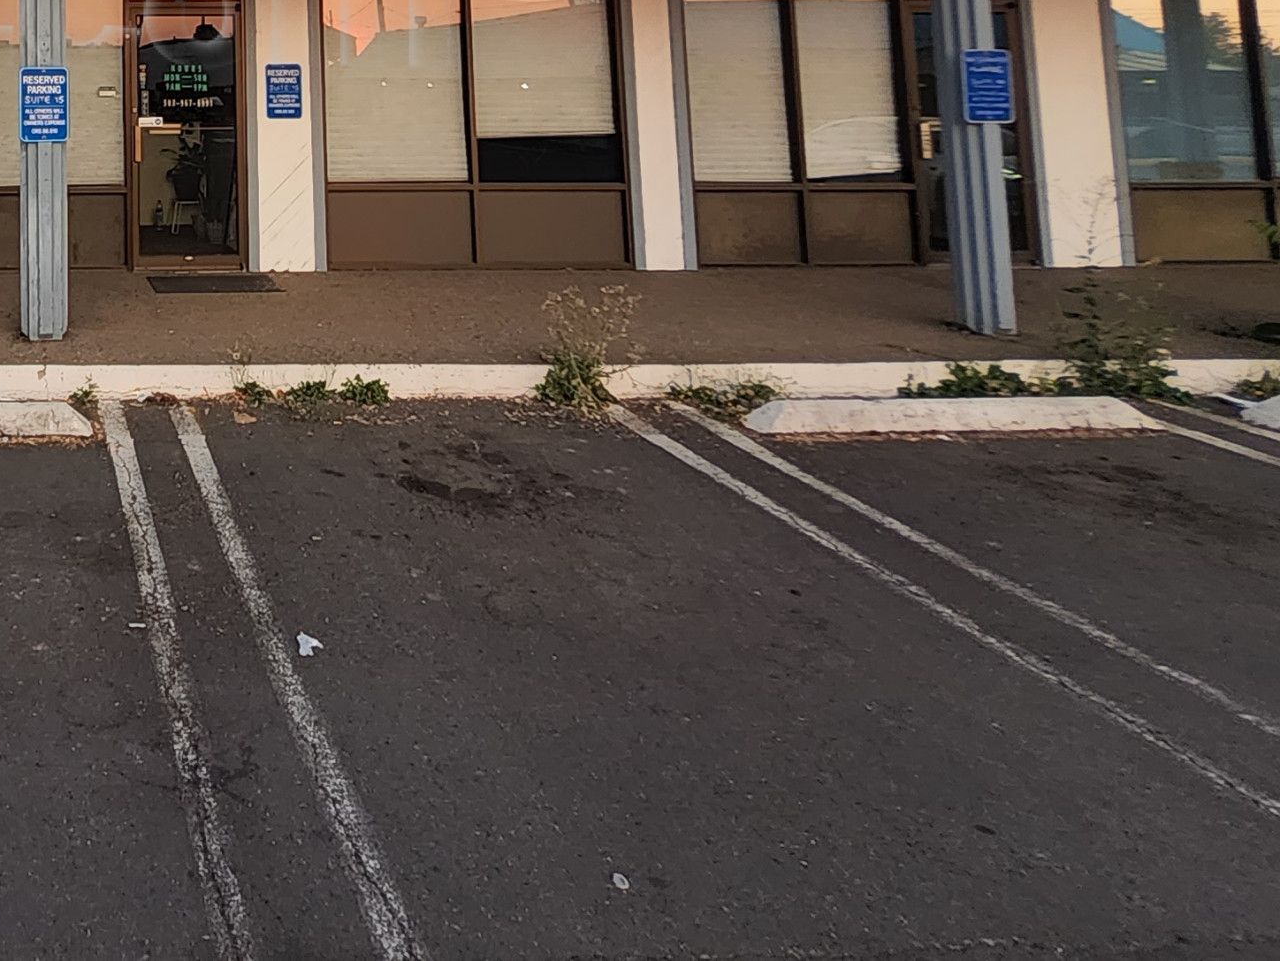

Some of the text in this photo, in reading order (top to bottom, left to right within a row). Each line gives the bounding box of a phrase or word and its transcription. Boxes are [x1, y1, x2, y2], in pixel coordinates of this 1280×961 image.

[170, 64, 202, 73] HOURS
[268, 69, 299, 77] RESERVED
[22, 75, 65, 84] RESERVED
[26, 85, 62, 94] PARKING
[24, 96, 65, 104] SUITE 15
